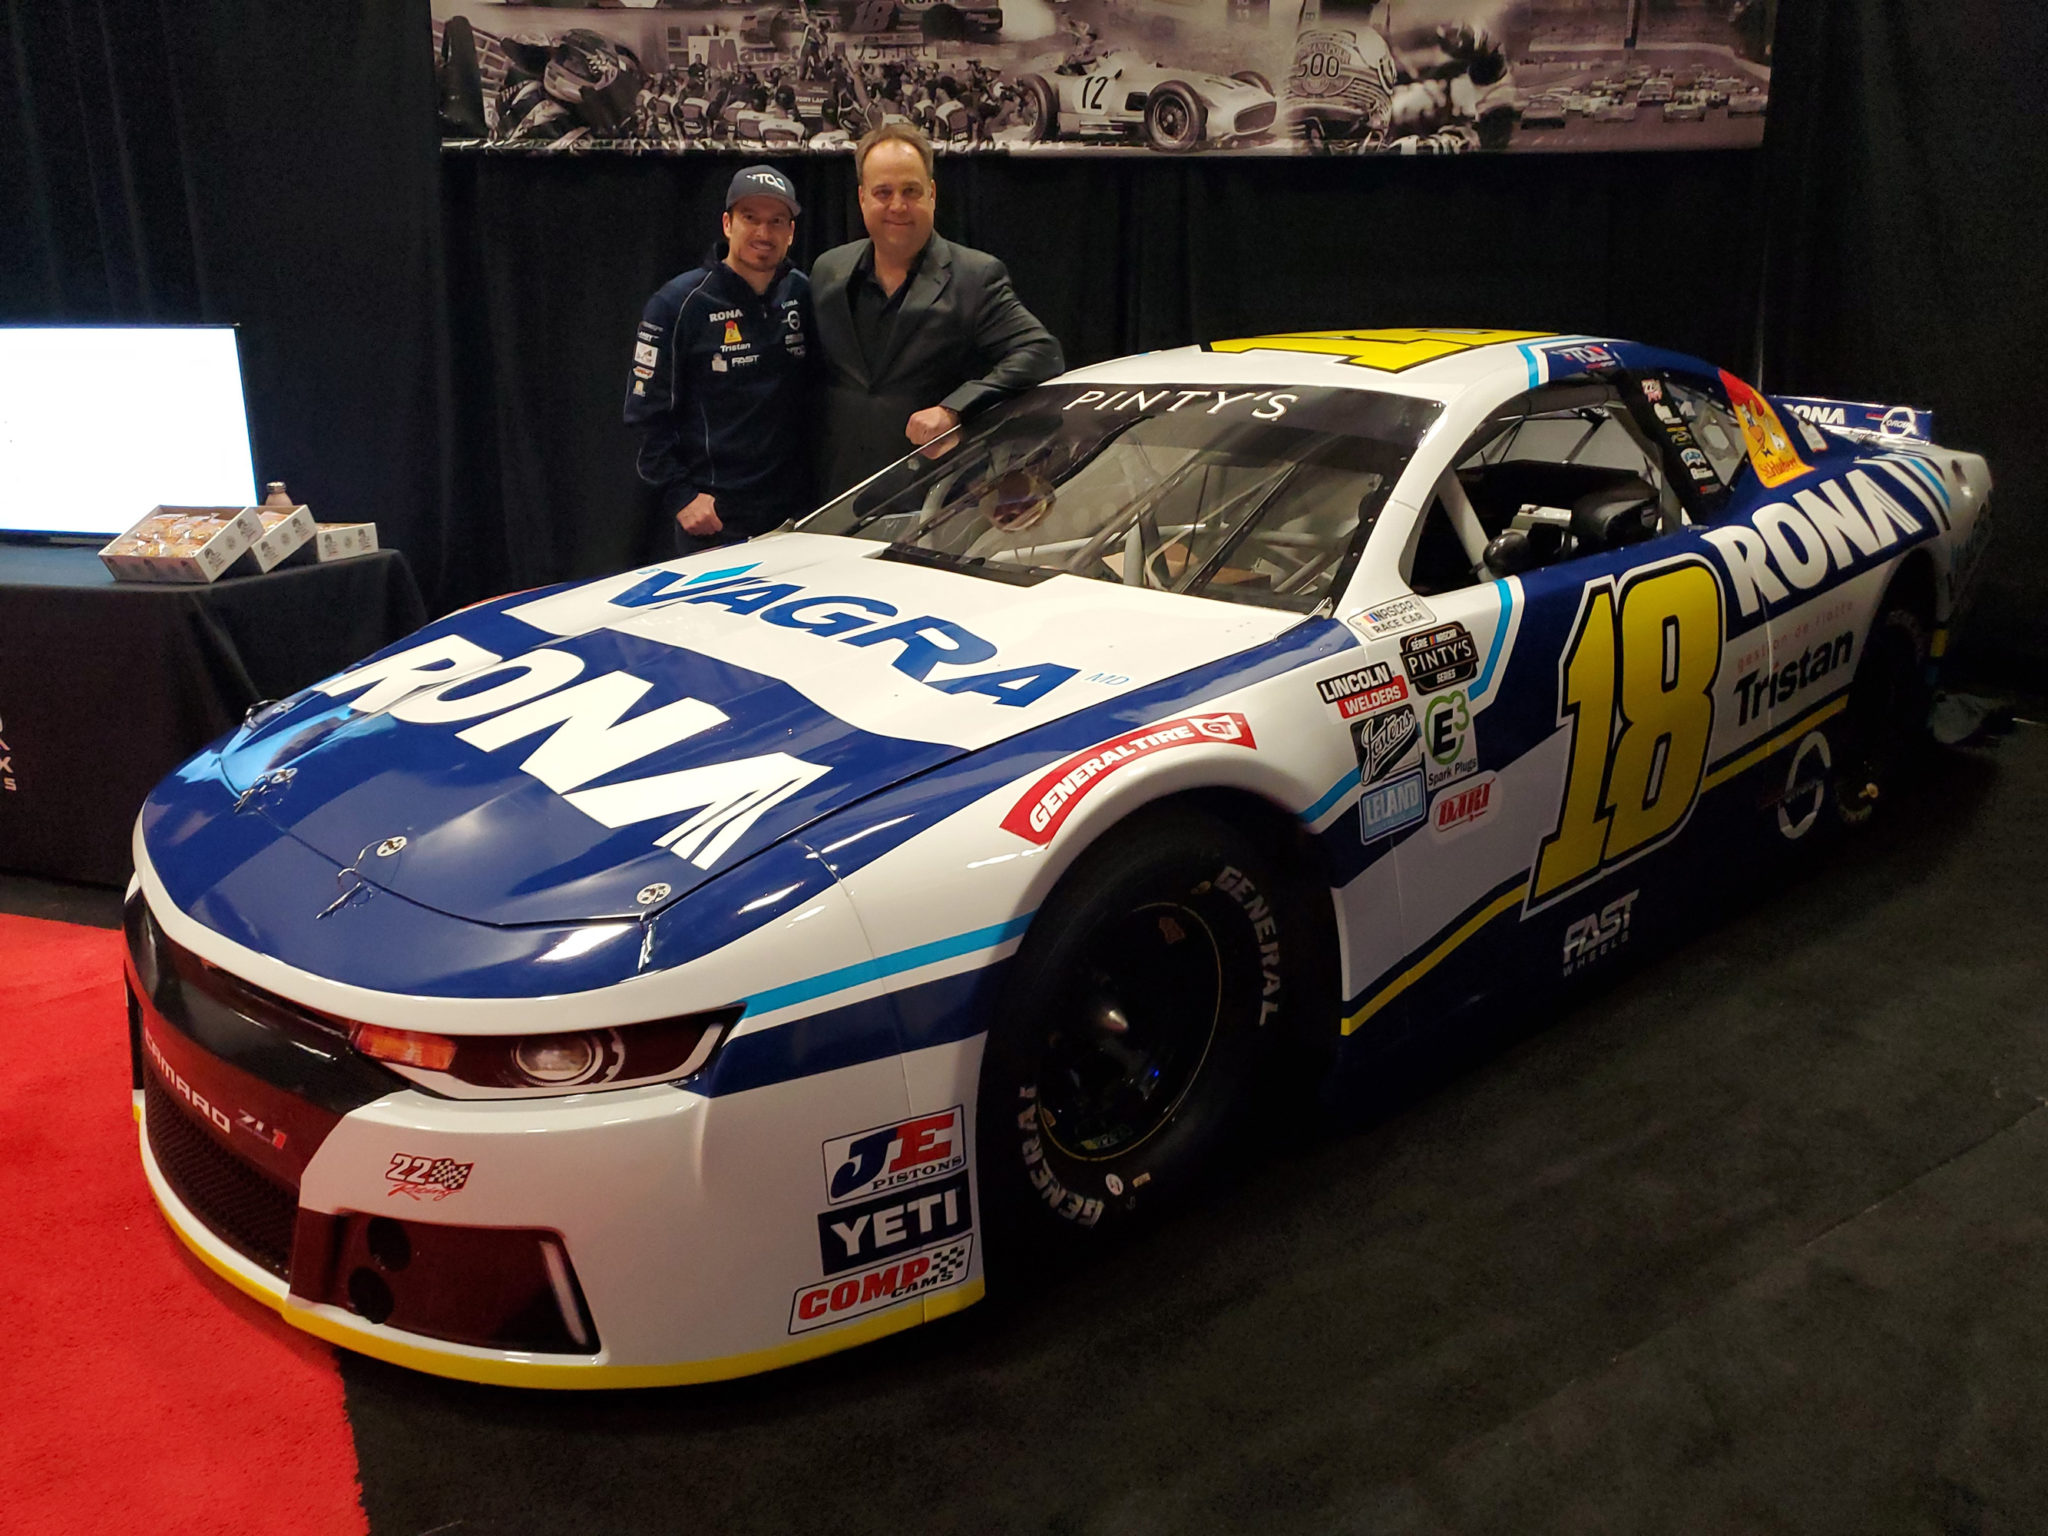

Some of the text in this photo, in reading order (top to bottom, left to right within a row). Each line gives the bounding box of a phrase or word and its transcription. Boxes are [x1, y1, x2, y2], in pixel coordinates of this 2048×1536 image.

[1081, 76, 1109, 110] 12
[709, 308, 744, 323] RONA
[720, 342, 752, 353] Tristan
[1062, 390, 1299, 420] PINTY'S
[1700, 469, 1923, 617] RONA
[1371, 612, 1425, 634] RACE CAR
[1372, 600, 1417, 621] NASCAR
[1407, 639, 1473, 675] PINTY'S
[1086, 671, 1130, 687] MD
[1320, 664, 1391, 701] LINCOLN
[1436, 668, 1457, 684] SERIES
[1733, 631, 1854, 727] Tristan
[1344, 684, 1402, 716] WELDERS
[313, 634, 834, 870] RONA
[1522, 555, 1726, 919] 18
[1029, 742, 1137, 833] GENERAL
[1128, 725, 1195, 750] TIRE
[1428, 757, 1477, 786] Spark Plugs
[1365, 780, 1420, 827] LELAND
[1563, 888, 1641, 963] FAST
[1214, 865, 1281, 1027] GENERAL
[145, 1027, 287, 1150] CAMARO ZL1
[385, 1152, 434, 1186] 22
[830, 1113, 955, 1198] JE
[872, 1155, 963, 1190] PISTONS
[830, 1188, 958, 1257] YETI
[798, 1257, 930, 1320] COMP
[890, 1270, 954, 1299] CAMS
